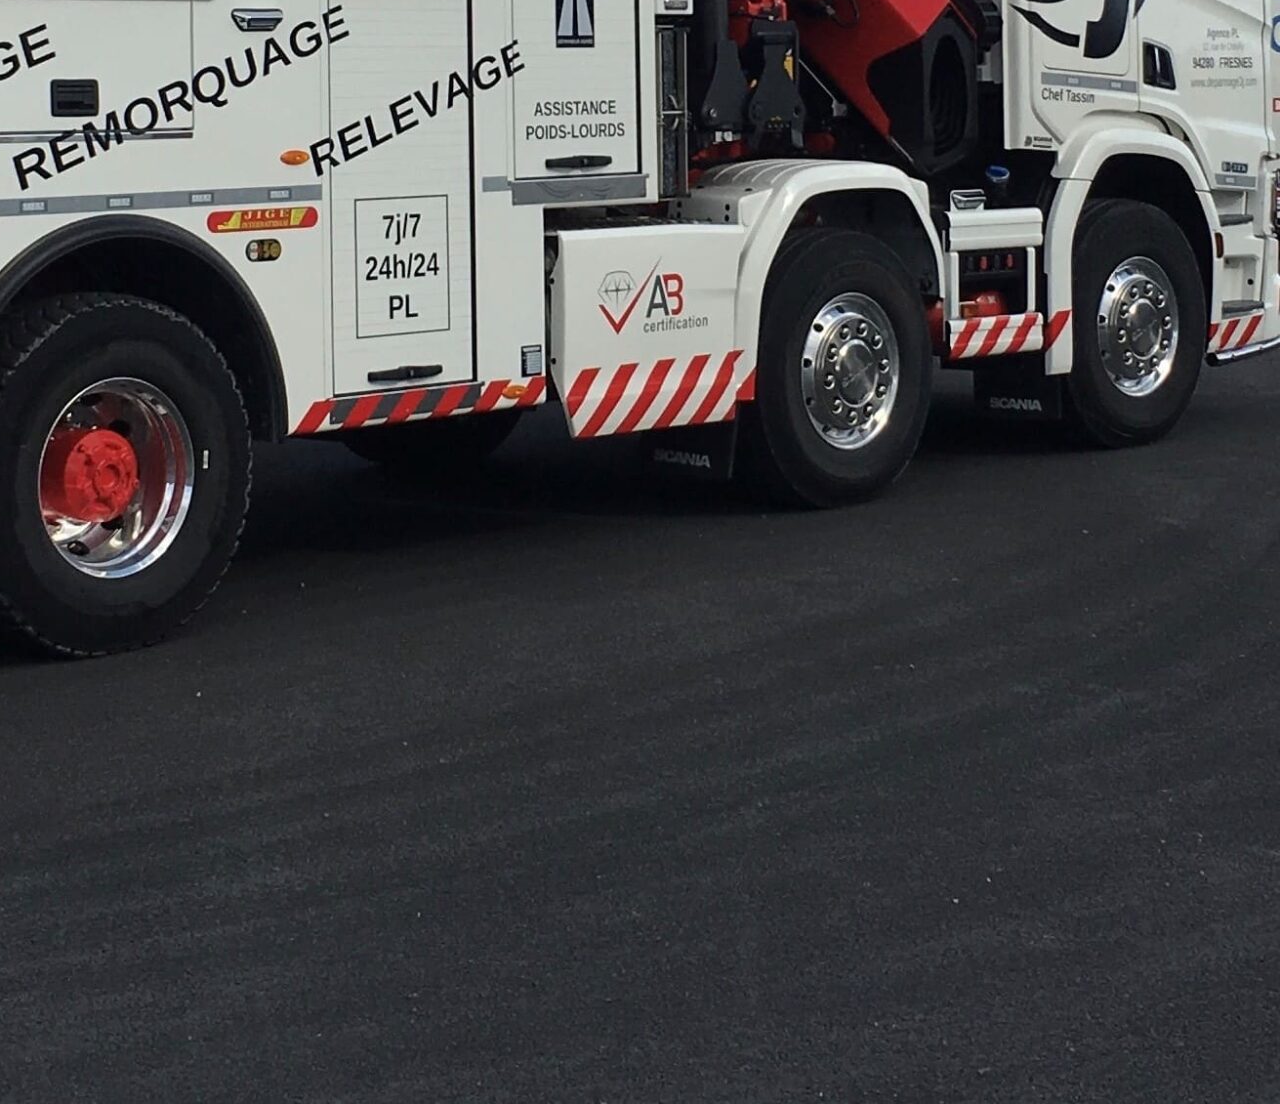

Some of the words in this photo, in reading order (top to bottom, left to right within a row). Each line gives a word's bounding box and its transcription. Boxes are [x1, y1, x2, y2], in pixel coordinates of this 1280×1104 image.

[12, 5, 352, 191] REMORQUAGE
[1041, 87, 1063, 101] Chef
[309, 40, 527, 177] RELEVAGE
[534, 99, 617, 117] ASSISTANCE
[525, 122, 625, 140] POIDS-LOURDS
[243, 208, 289, 220] JIGE
[382, 212, 422, 246] 7j/7
[365, 252, 440, 281] 24h/24
[389, 293, 419, 320] PL
[645, 273, 684, 318] AB
[642, 316, 709, 333] certification
[989, 396, 1043, 412] SCANIA
